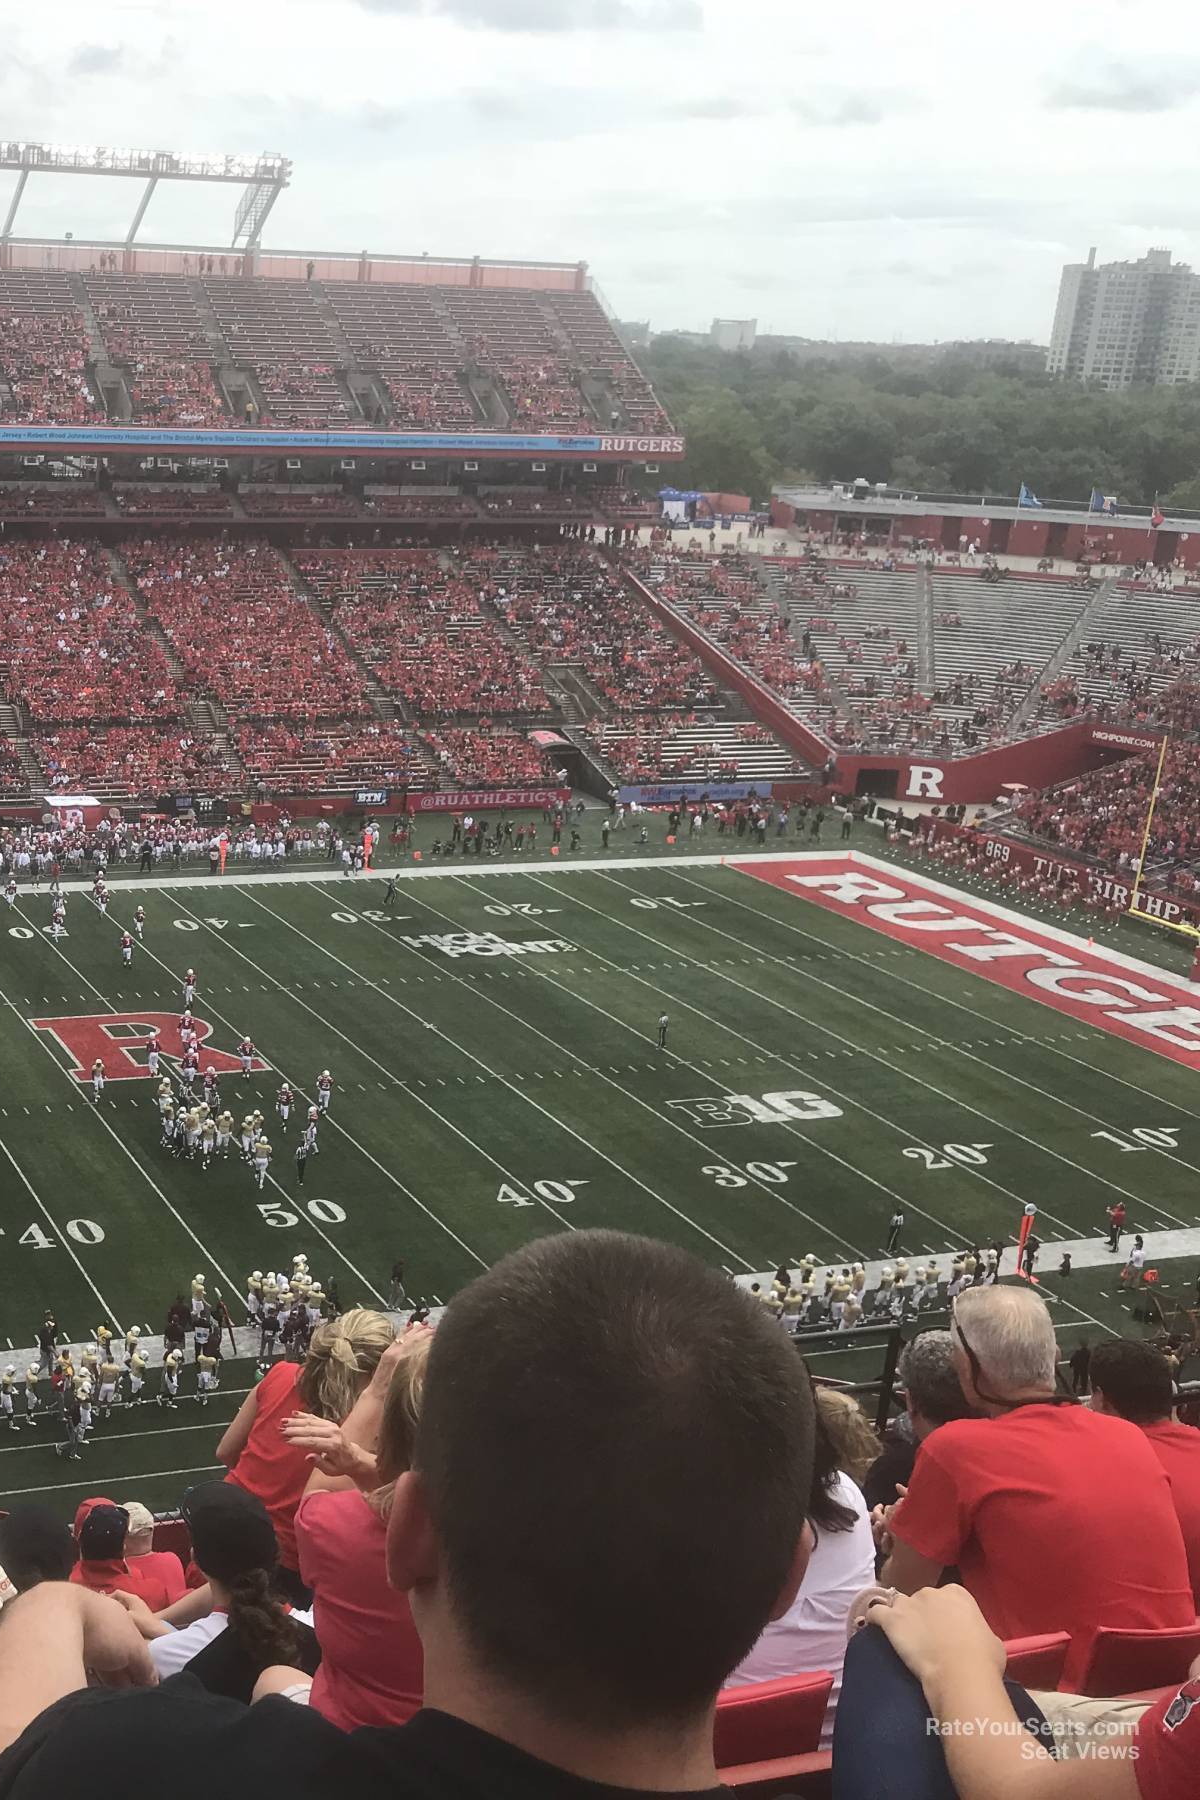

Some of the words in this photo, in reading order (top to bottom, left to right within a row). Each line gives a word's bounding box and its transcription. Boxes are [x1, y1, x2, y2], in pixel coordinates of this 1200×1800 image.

[2, 431, 21, 439] Jersey
[94, 433, 122, 441] University
[600, 438, 684, 452] RUTGERS
[1092, 730, 1155, 749] HIGHPOINT.COM
[905, 765, 944, 799] R
[357, 791, 383, 802] BTN
[331, 910, 392, 924] 30
[483, 903, 543, 916] 20
[173, 917, 230, 931] 40
[27, 1012, 272, 1083] R
[1091, 1126, 1179, 1152] 10
[902, 1143, 988, 1169] 20
[701, 1160, 790, 1188] 30
[496, 1179, 577, 1207] 40
[256, 1199, 347, 1229] 50
[18, 1218, 106, 1250] 40
